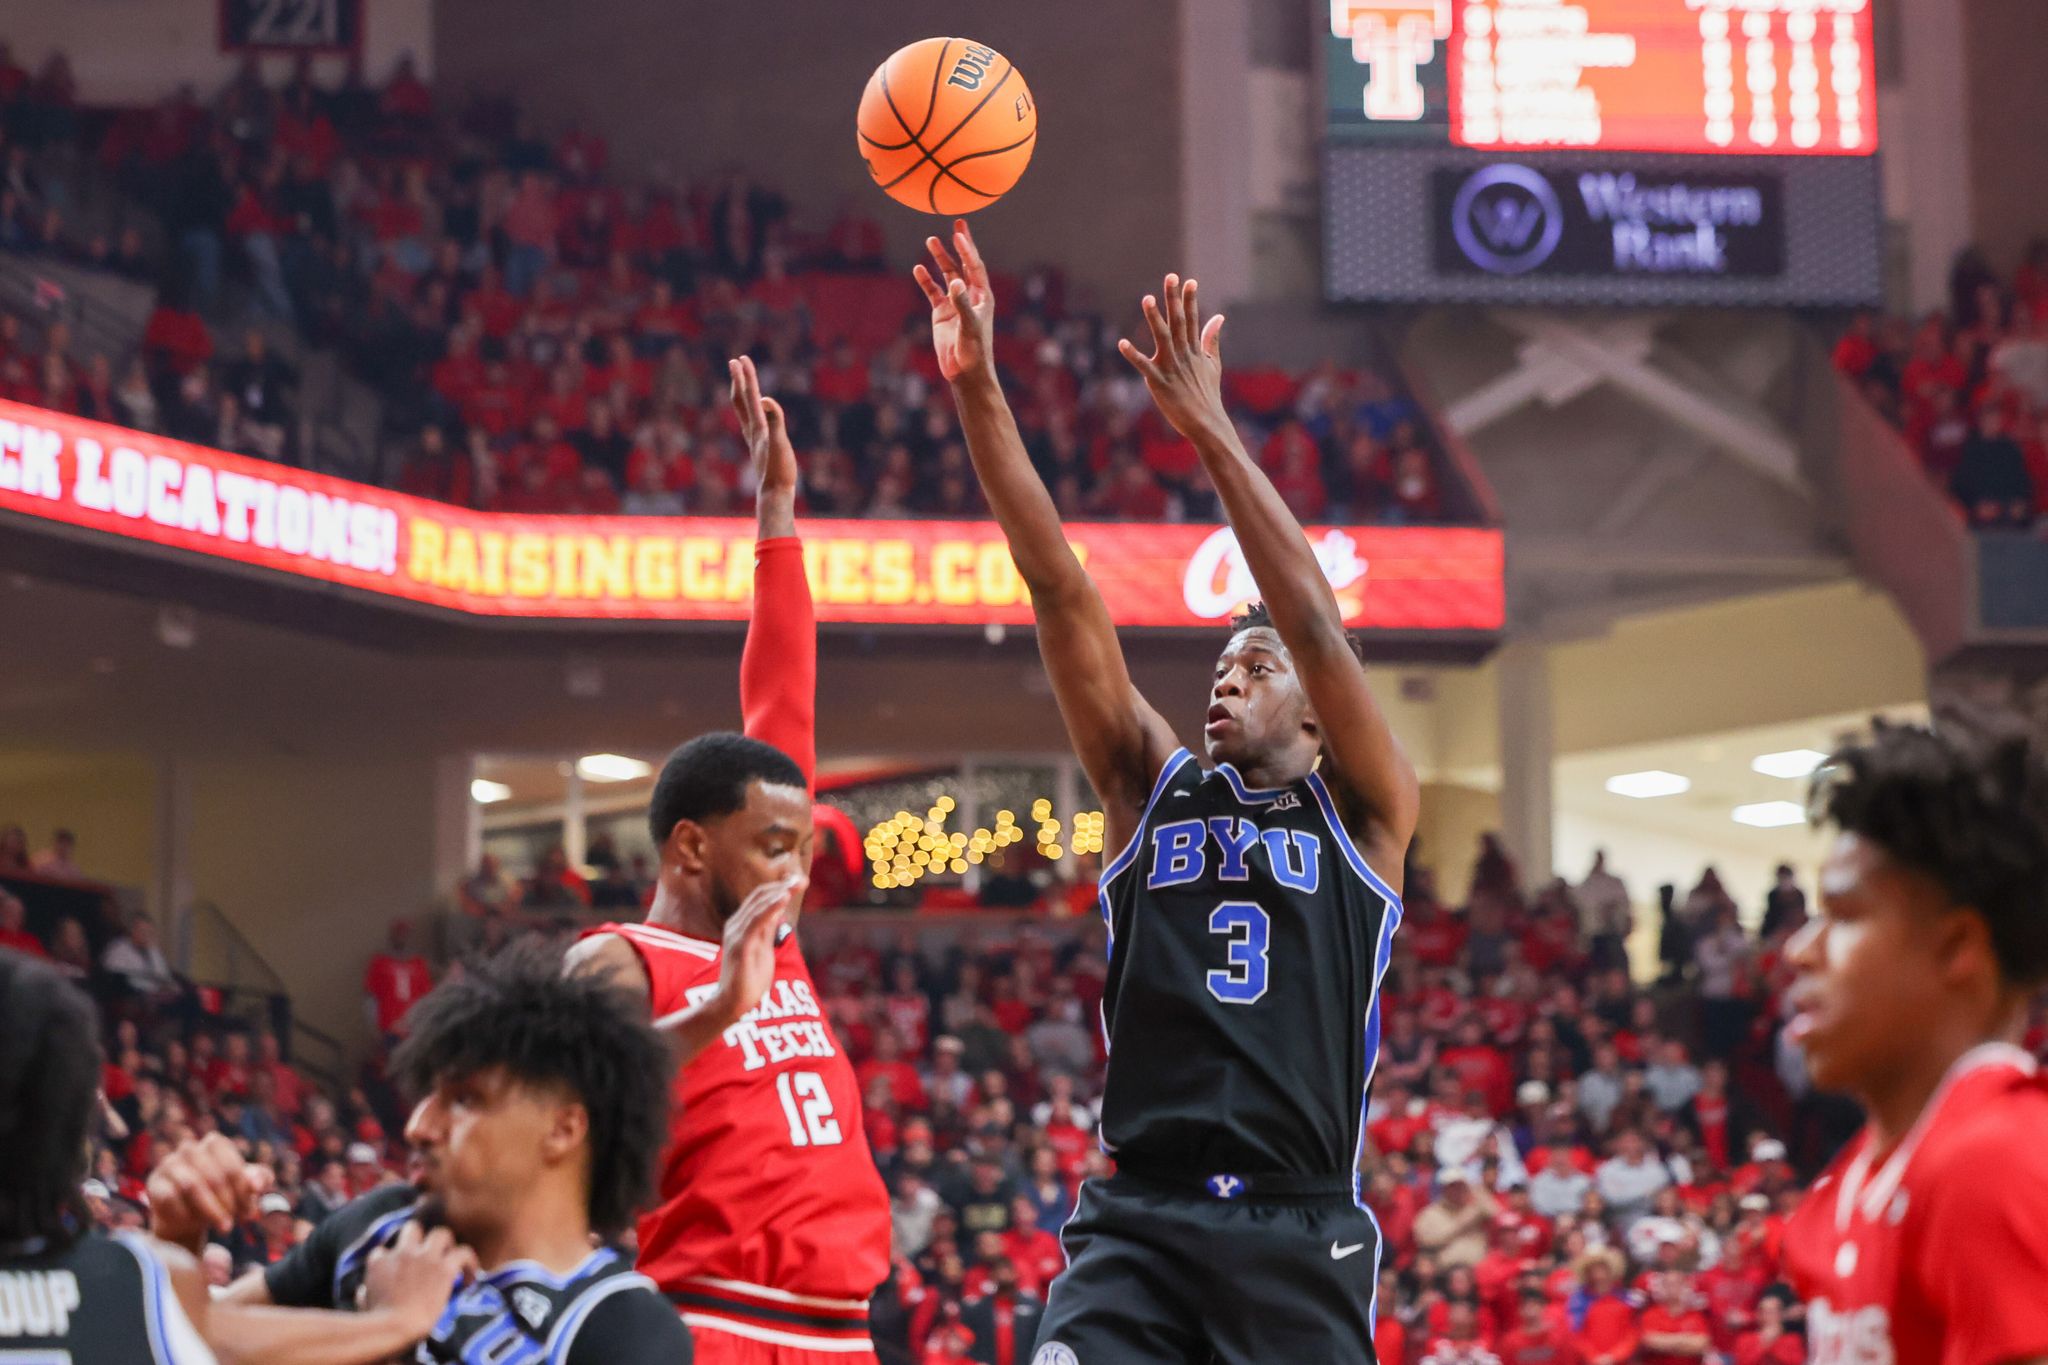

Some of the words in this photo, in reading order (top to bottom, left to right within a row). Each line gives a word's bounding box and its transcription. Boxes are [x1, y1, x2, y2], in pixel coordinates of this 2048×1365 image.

[74, 438, 397, 576] LOCATIONS!
[410, 518, 1087, 608] RAISINGCAES.CO
[1147, 816, 1321, 895] BYU
[1207, 900, 1271, 1005] 3
[723, 1020, 836, 1072] TECH
[776, 1071, 843, 1146] 12
